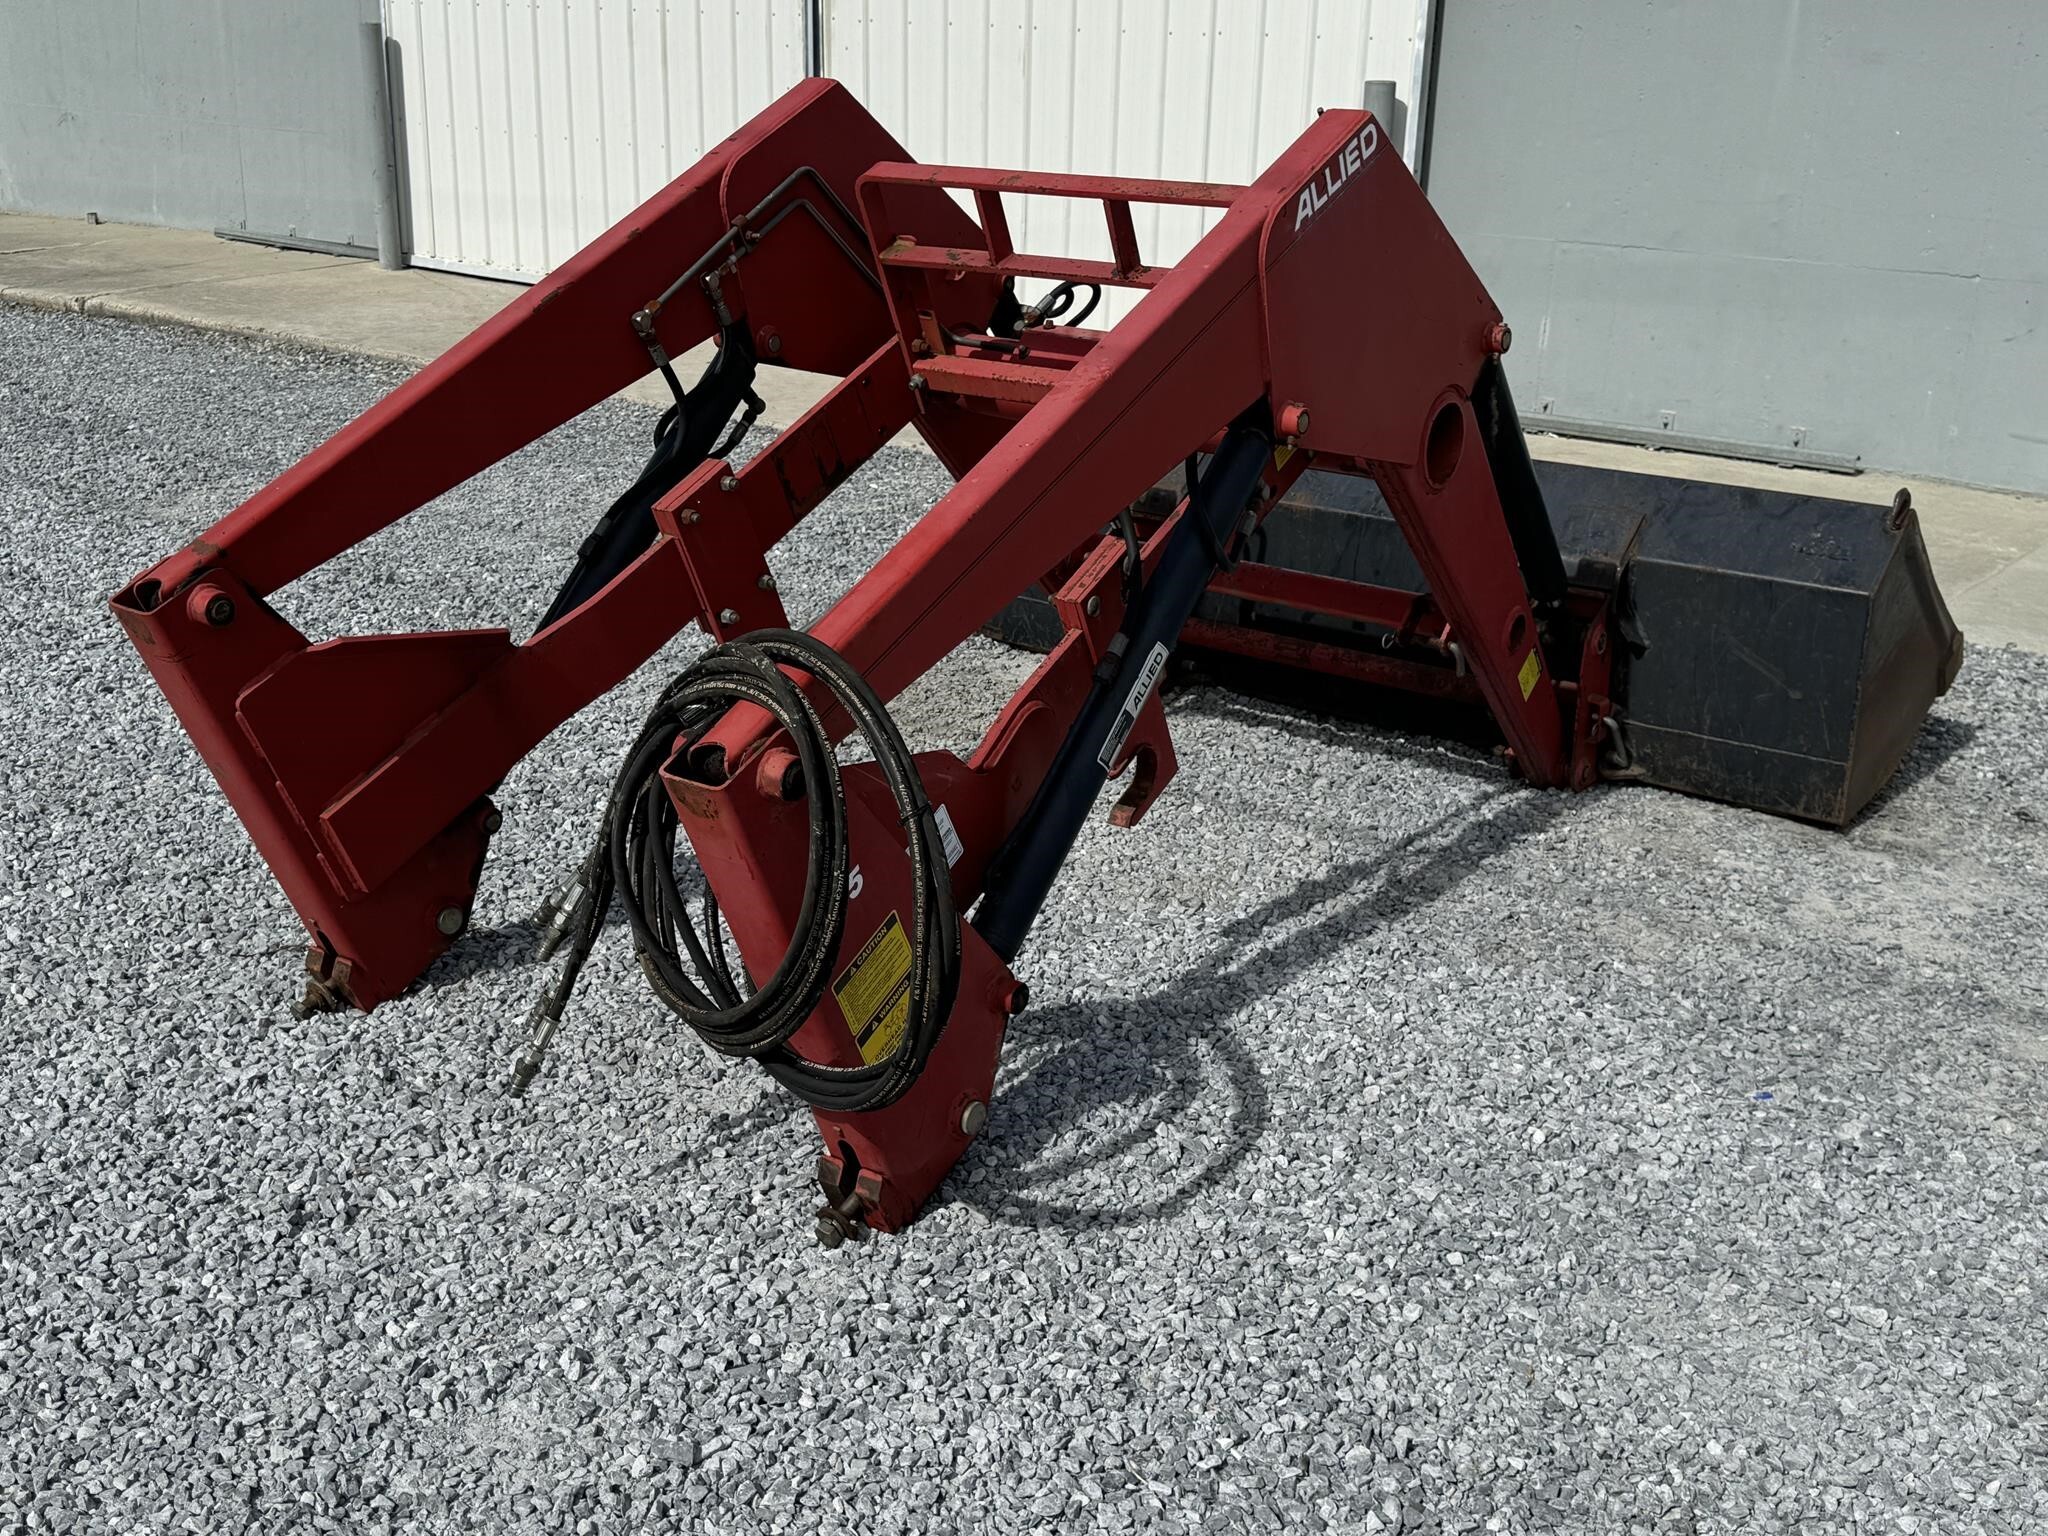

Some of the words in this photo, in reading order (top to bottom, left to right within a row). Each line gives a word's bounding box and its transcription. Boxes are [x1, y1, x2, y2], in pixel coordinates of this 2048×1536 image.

[1295, 123, 1377, 232] ALLIED
[1134, 652, 1163, 711] ALLIED
[856, 927, 887, 965] CAUTION
[914, 957, 922, 984] Products
[879, 980, 909, 1019] WARNING
